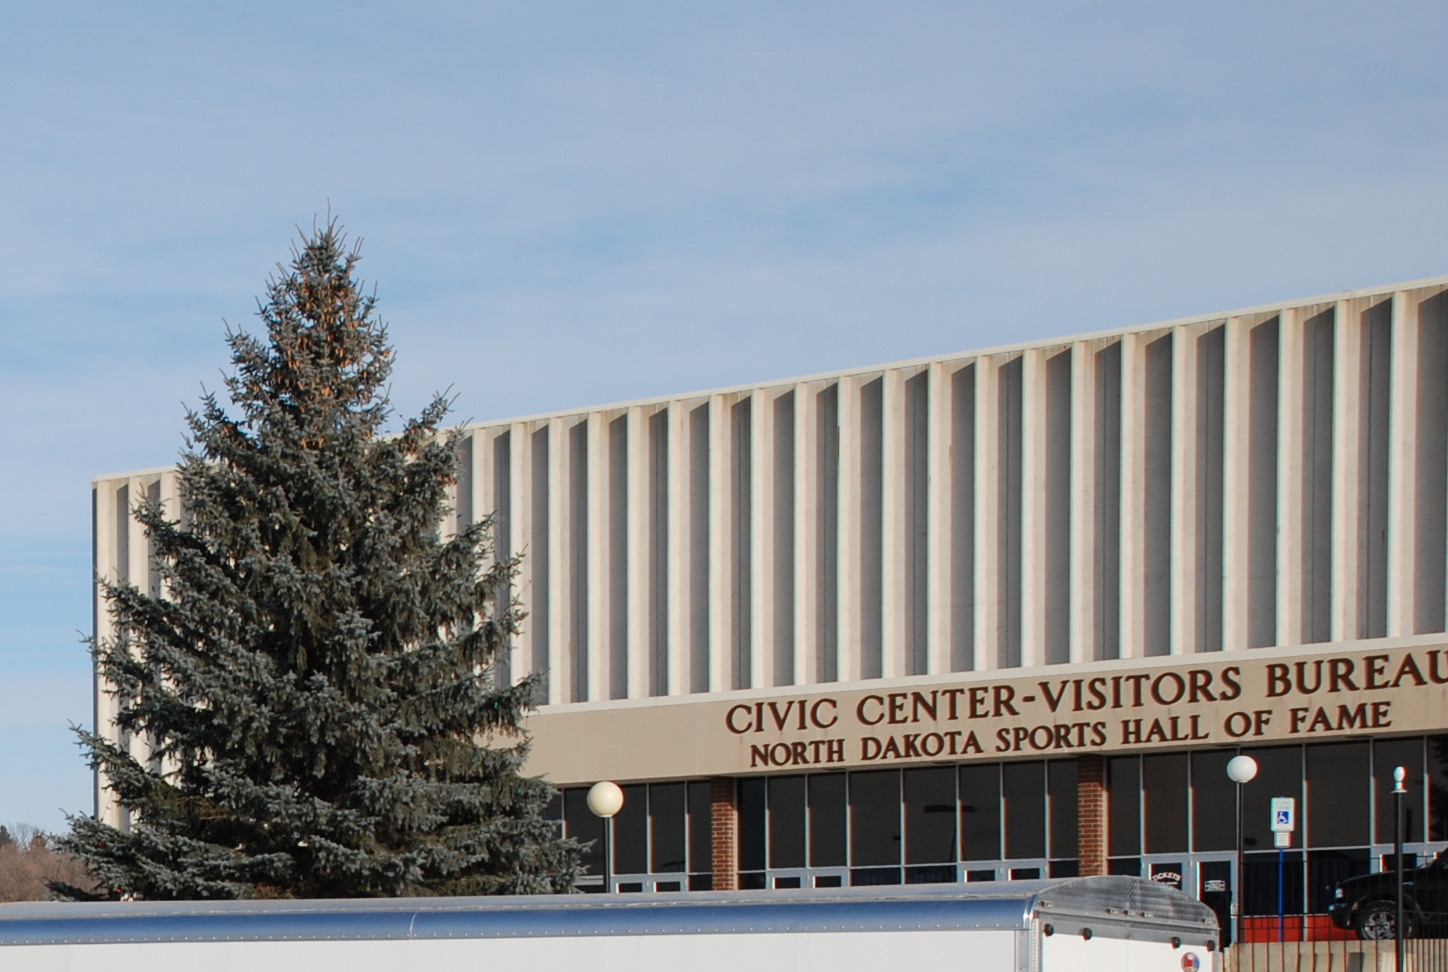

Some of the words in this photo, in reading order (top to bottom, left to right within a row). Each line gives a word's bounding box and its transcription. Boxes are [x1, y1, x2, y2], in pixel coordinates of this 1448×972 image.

[725, 698, 838, 734] CIVIC
[856, 666, 1242, 726] CENTER-VISITORS
[1265, 650, 1448, 698] BUREAU
[749, 738, 845, 767] NORTH
[860, 730, 984, 761] DAKOTA
[995, 721, 1107, 752] SPORTS
[1120, 714, 1210, 745] HALL
[1223, 711, 1273, 738] OF
[1288, 701, 1392, 734] FAME
[1152, 872, 1182, 881] TICKETS
